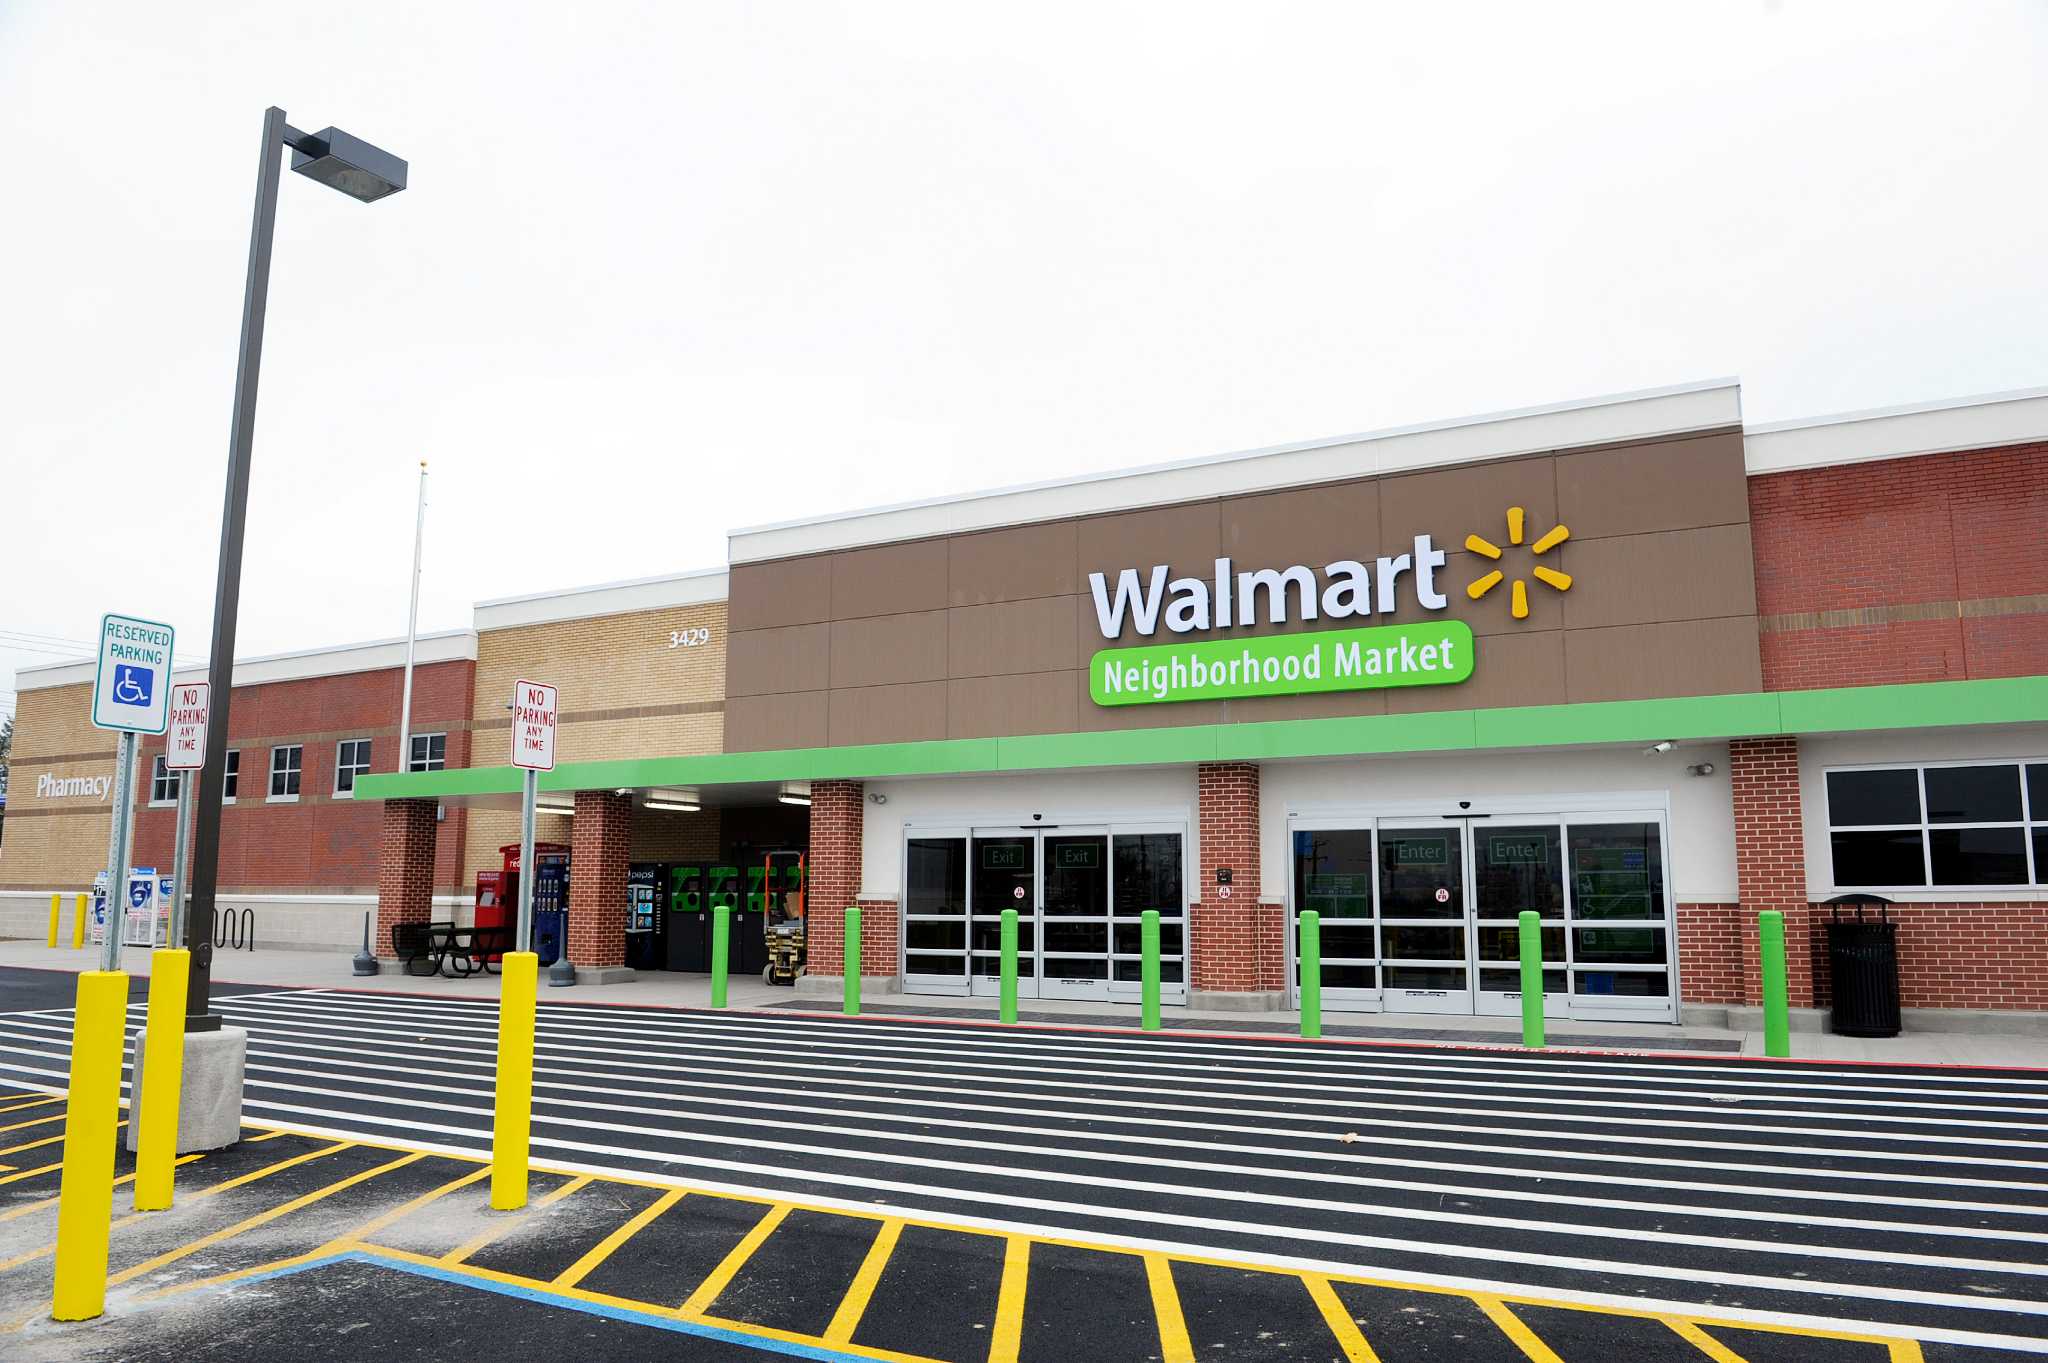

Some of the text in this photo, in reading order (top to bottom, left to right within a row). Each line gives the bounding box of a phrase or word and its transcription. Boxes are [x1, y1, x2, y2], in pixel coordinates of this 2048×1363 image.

[1088, 534, 1448, 639] Walmart
[107, 623, 170, 646] RESERVED
[669, 628, 709, 649] 3429
[110, 643, 162, 665] PARKING
[1104, 637, 1455, 699] Neighborhood Market
[183, 690, 198, 706] NO
[528, 689, 545, 706] NO
[172, 709, 206, 724] PARKING
[516, 706, 554, 727] PARKING
[180, 726, 195, 737] ANY
[526, 726, 543, 737] ANY
[177, 739, 196, 750] TIME
[524, 738, 544, 751] TIME
[36, 772, 112, 802] Pharmacy
[992, 850, 1014, 864] Exit
[1065, 849, 1088, 863] Exit
[1399, 844, 1441, 858] Enter
[1496, 842, 1540, 857] Enter
[631, 869, 654, 880] pepsi
